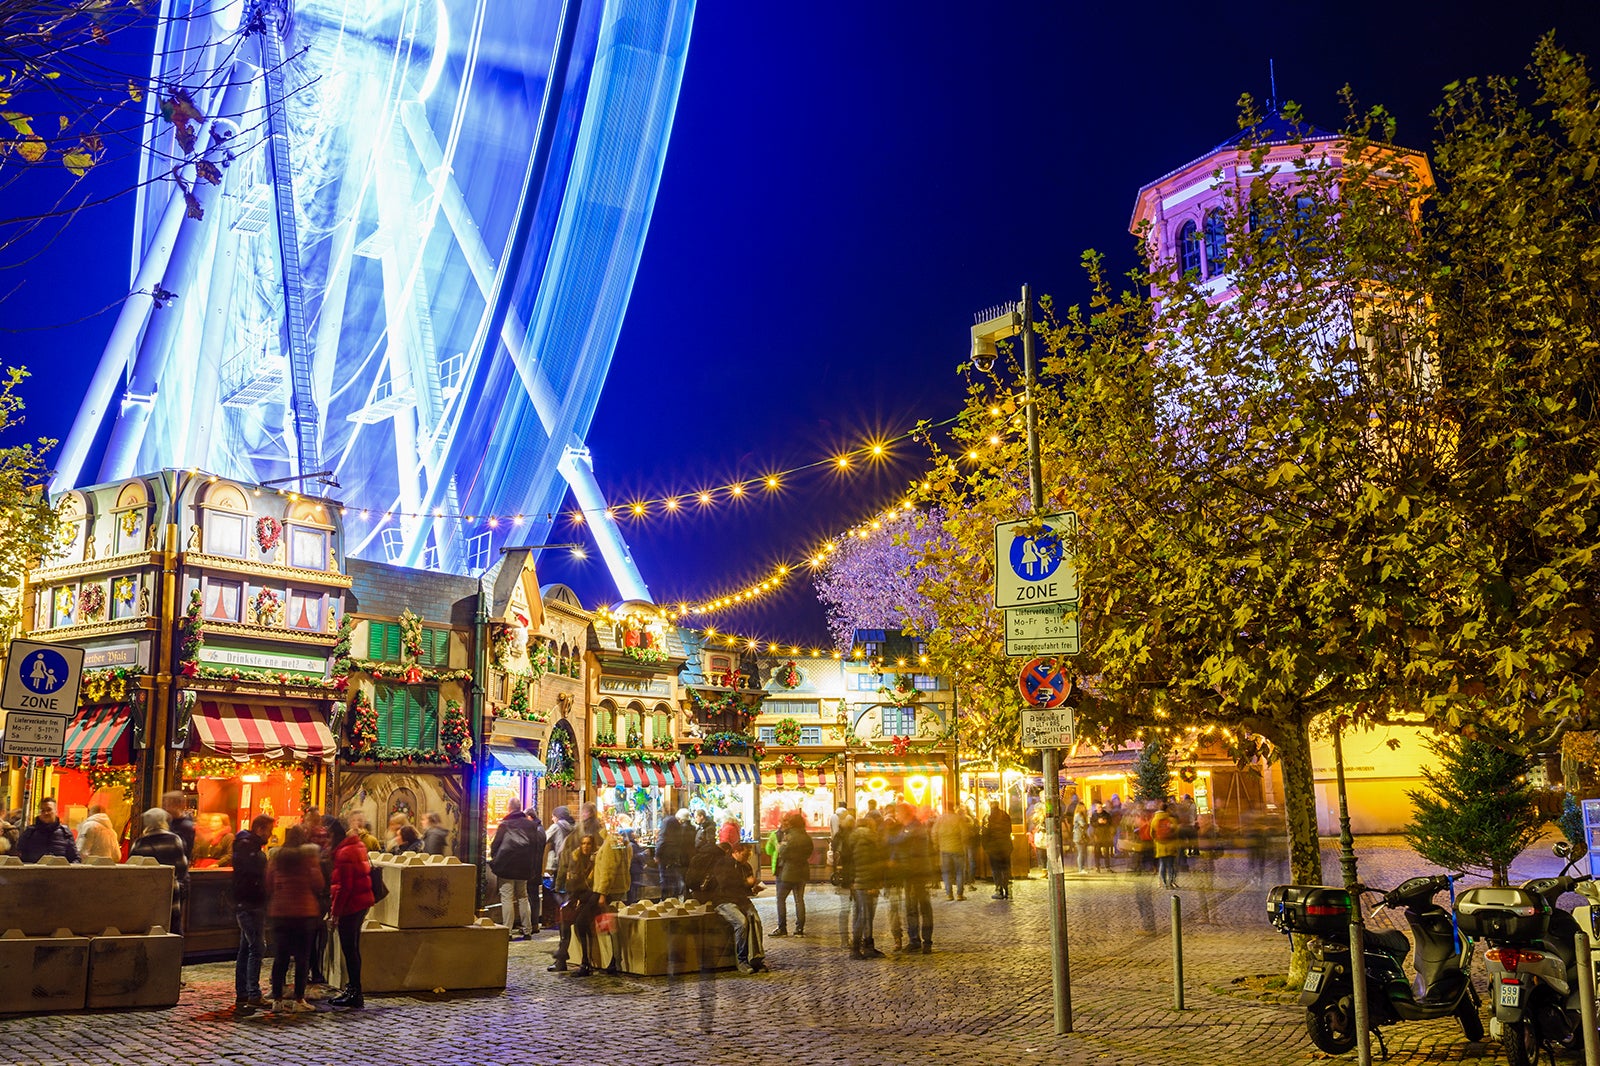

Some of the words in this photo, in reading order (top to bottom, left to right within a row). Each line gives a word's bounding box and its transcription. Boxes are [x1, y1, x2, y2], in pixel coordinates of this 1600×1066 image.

[1016, 583, 1058, 601] ZONE
[1014, 618, 1037, 626] Mo-Fr
[1013, 643, 1059, 652] Garagenzufahrt
[1061, 641, 1073, 649] frei
[227, 653, 261, 665] Drinkste
[264, 657, 279, 667] ene
[281, 660, 300, 668] met?
[20, 695, 59, 710] ZONE
[14, 716, 48, 725] Lieferverkehr
[49, 718, 59, 726] frei
[8, 744, 47, 753] Garagenzufahrt
[48, 746, 58, 754] frei
[1502, 986, 1517, 995] 599
[1502, 996, 1517, 1004] KRV
